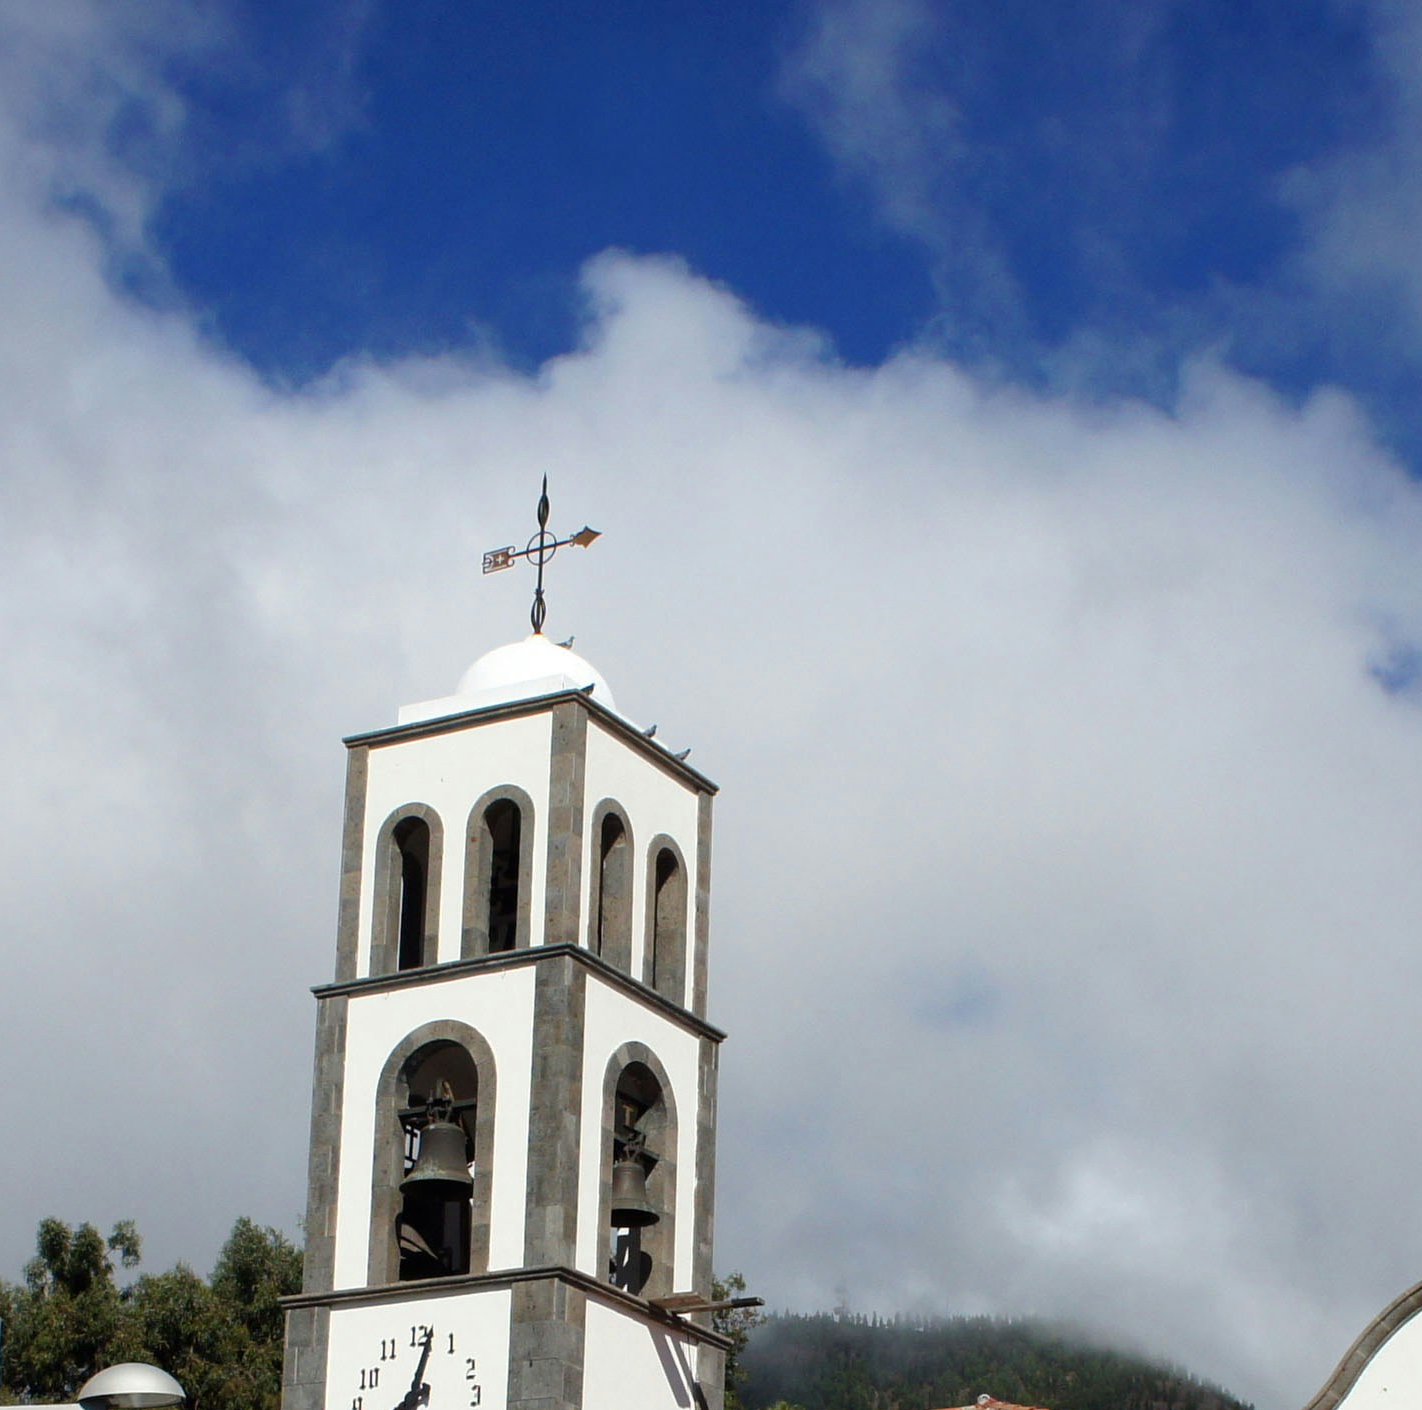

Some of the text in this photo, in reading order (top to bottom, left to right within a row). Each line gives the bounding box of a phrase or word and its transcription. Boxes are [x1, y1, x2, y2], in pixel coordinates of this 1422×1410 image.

[409, 1325, 430, 1347] 12
[447, 1333, 455, 1355] 1
[380, 1339, 397, 1361] 11
[359, 1368, 380, 1391] 10
[465, 1358, 476, 1381] 2
[470, 1385, 481, 1407] 3
